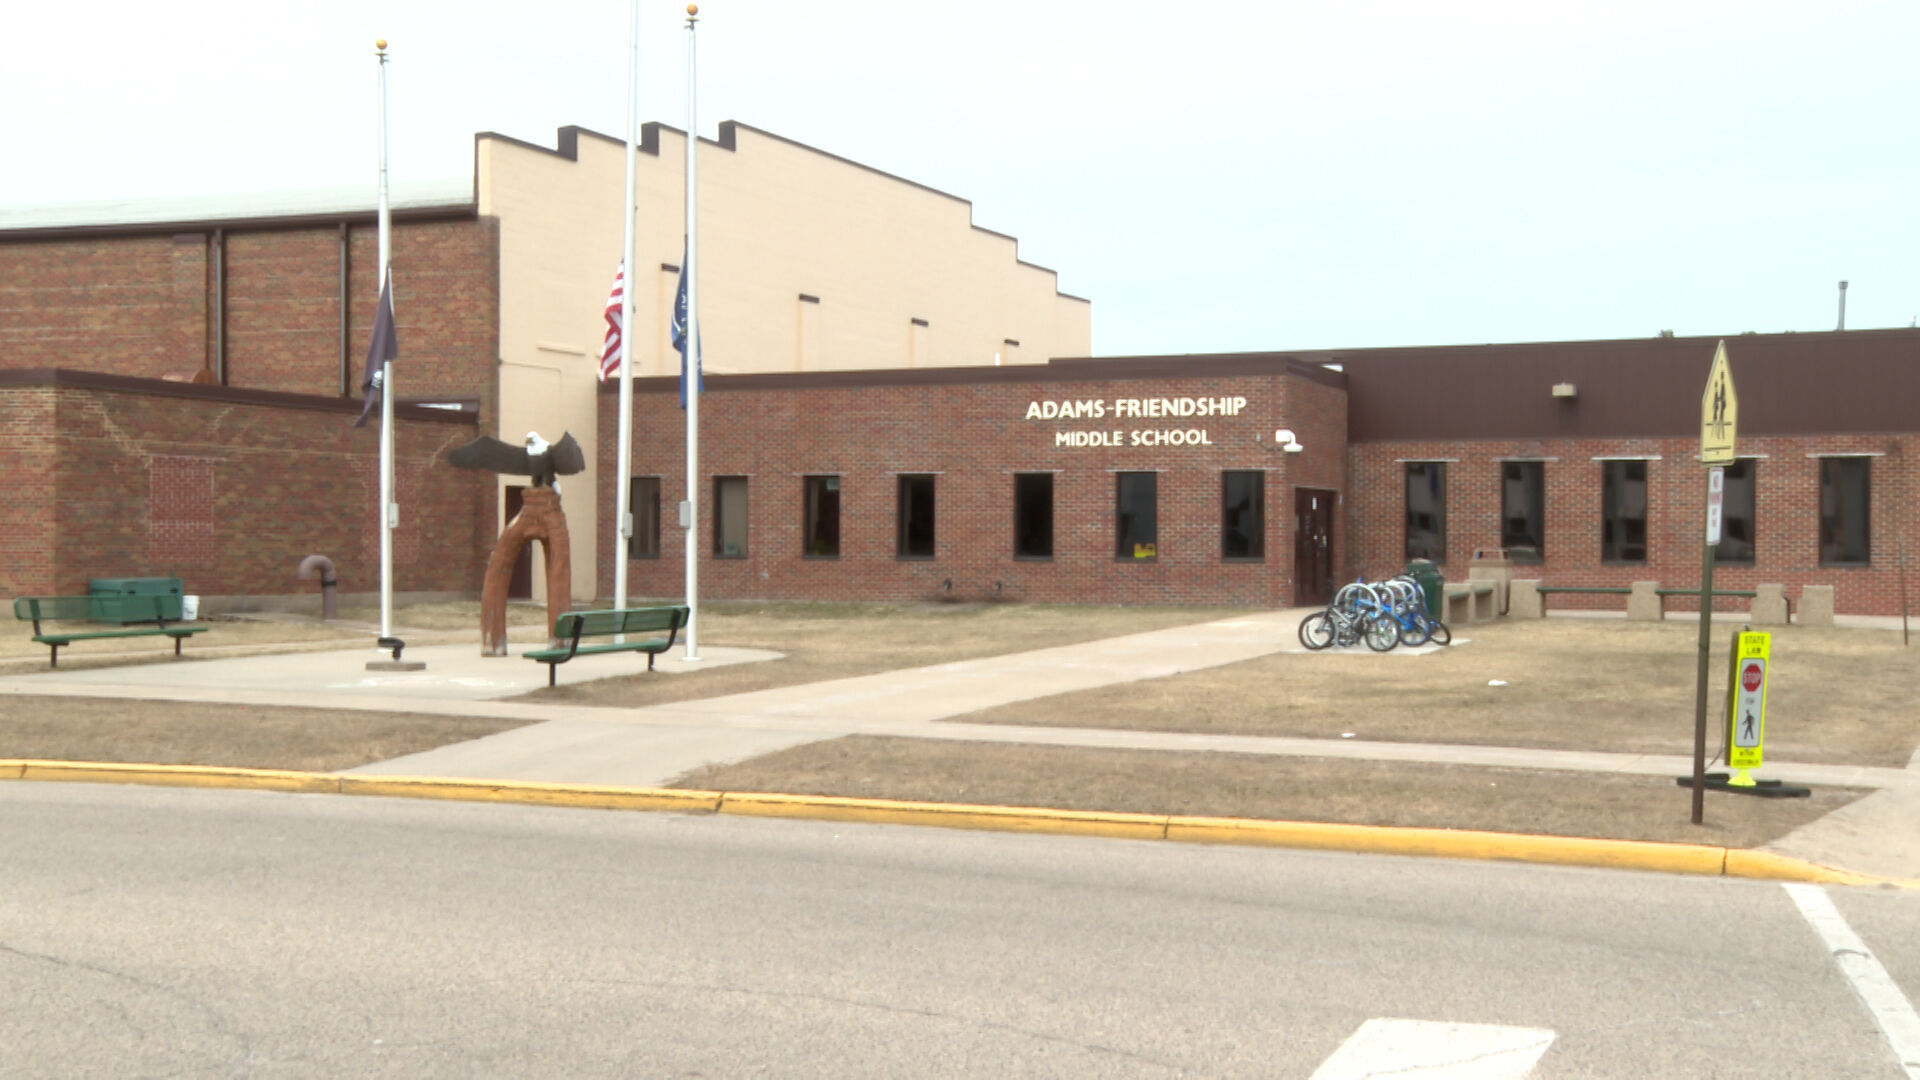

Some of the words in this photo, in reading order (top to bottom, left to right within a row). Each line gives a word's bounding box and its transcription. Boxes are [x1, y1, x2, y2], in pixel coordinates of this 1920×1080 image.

[1025, 397, 1247, 419] ADAMS-FRIENDSHIP
[1055, 431, 1124, 447] MIDDLE
[1131, 429, 1212, 446] SCHOOL
[1743, 672, 1761, 684] STOP
